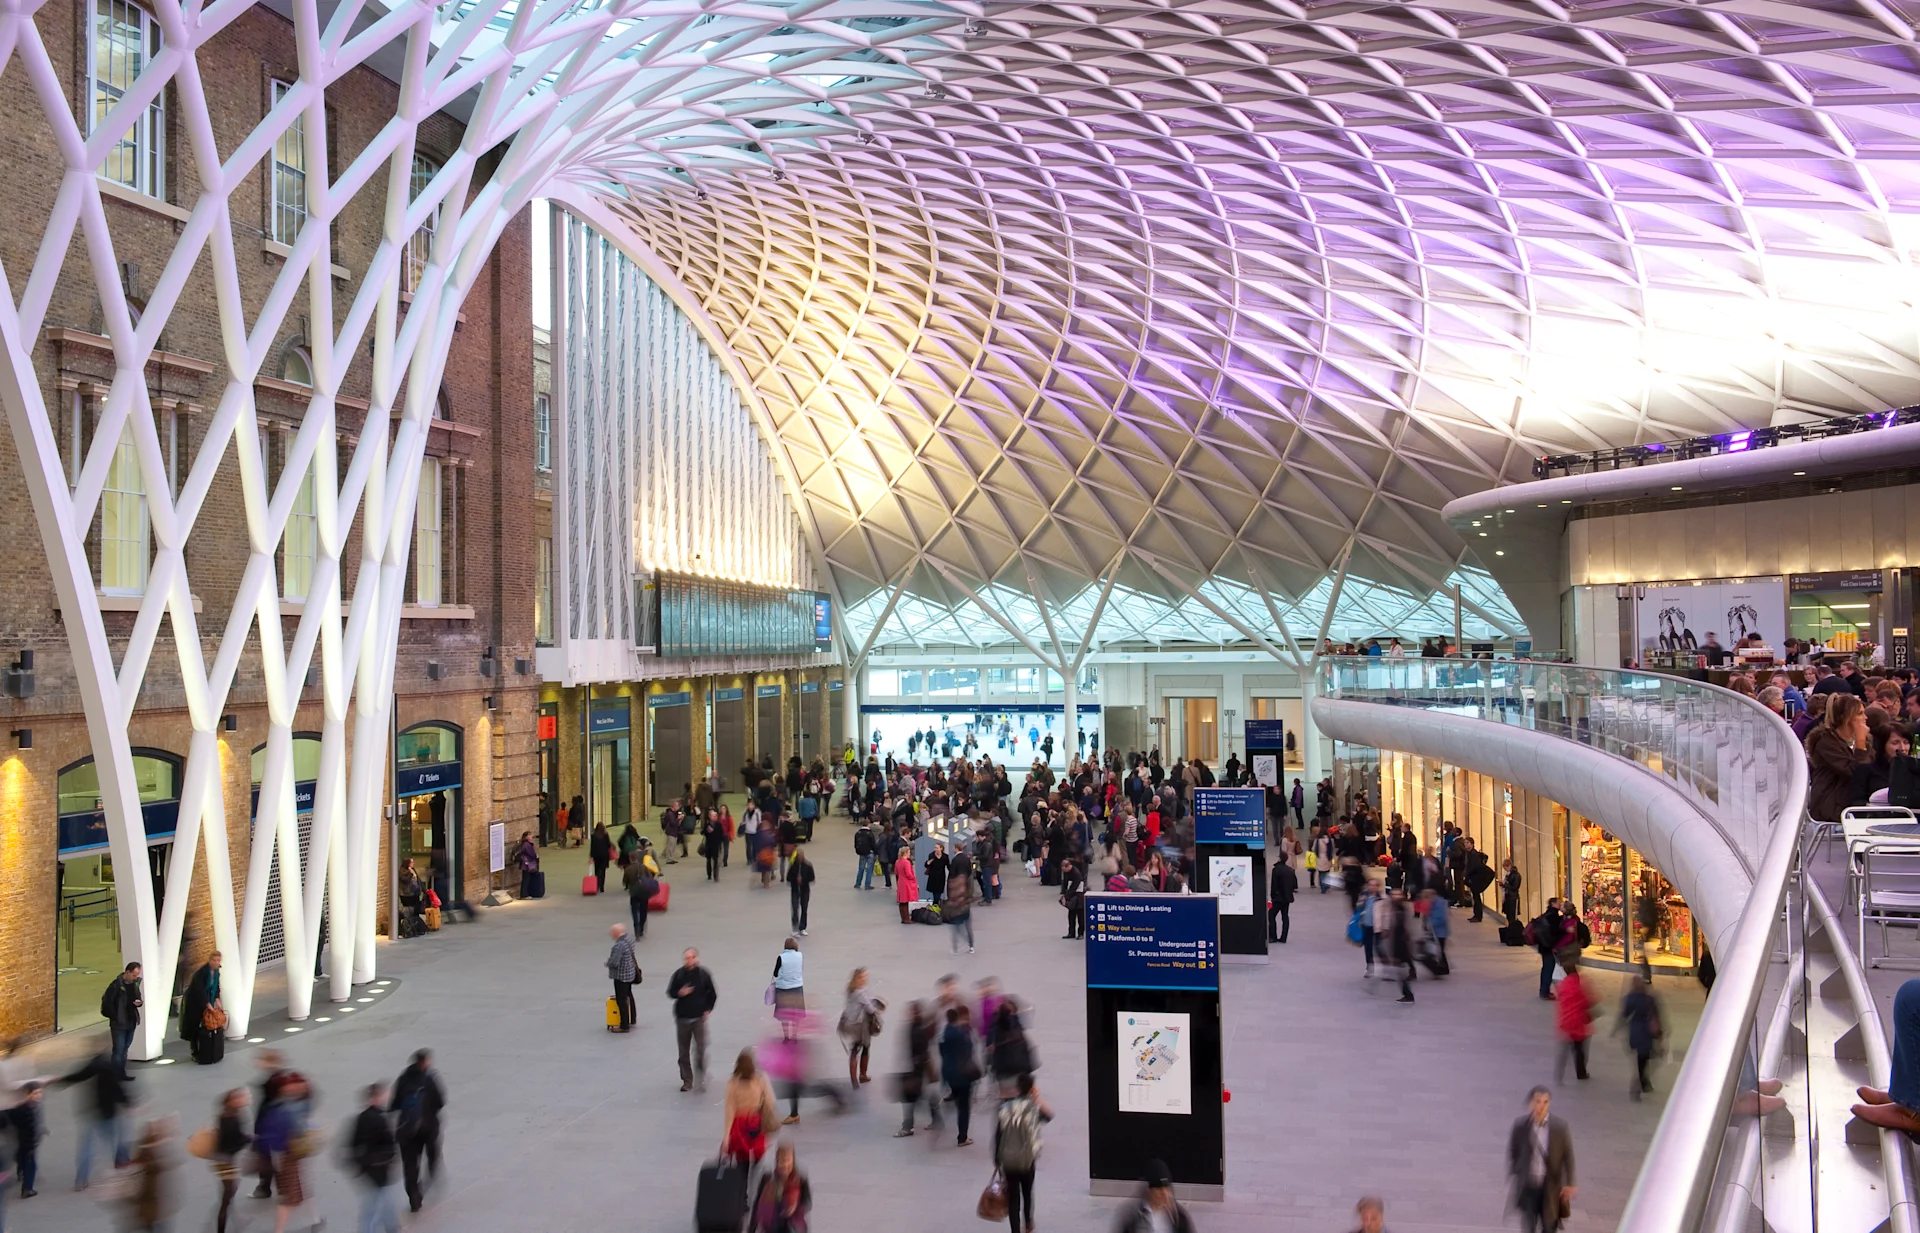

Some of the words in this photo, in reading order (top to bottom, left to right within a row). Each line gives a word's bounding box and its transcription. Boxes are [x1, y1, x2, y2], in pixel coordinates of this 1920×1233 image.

[425, 774, 440, 783] Tickets
[295, 793, 311, 802] ickets
[1150, 905, 1172, 913] seating
[1172, 961, 1185, 969] Way
